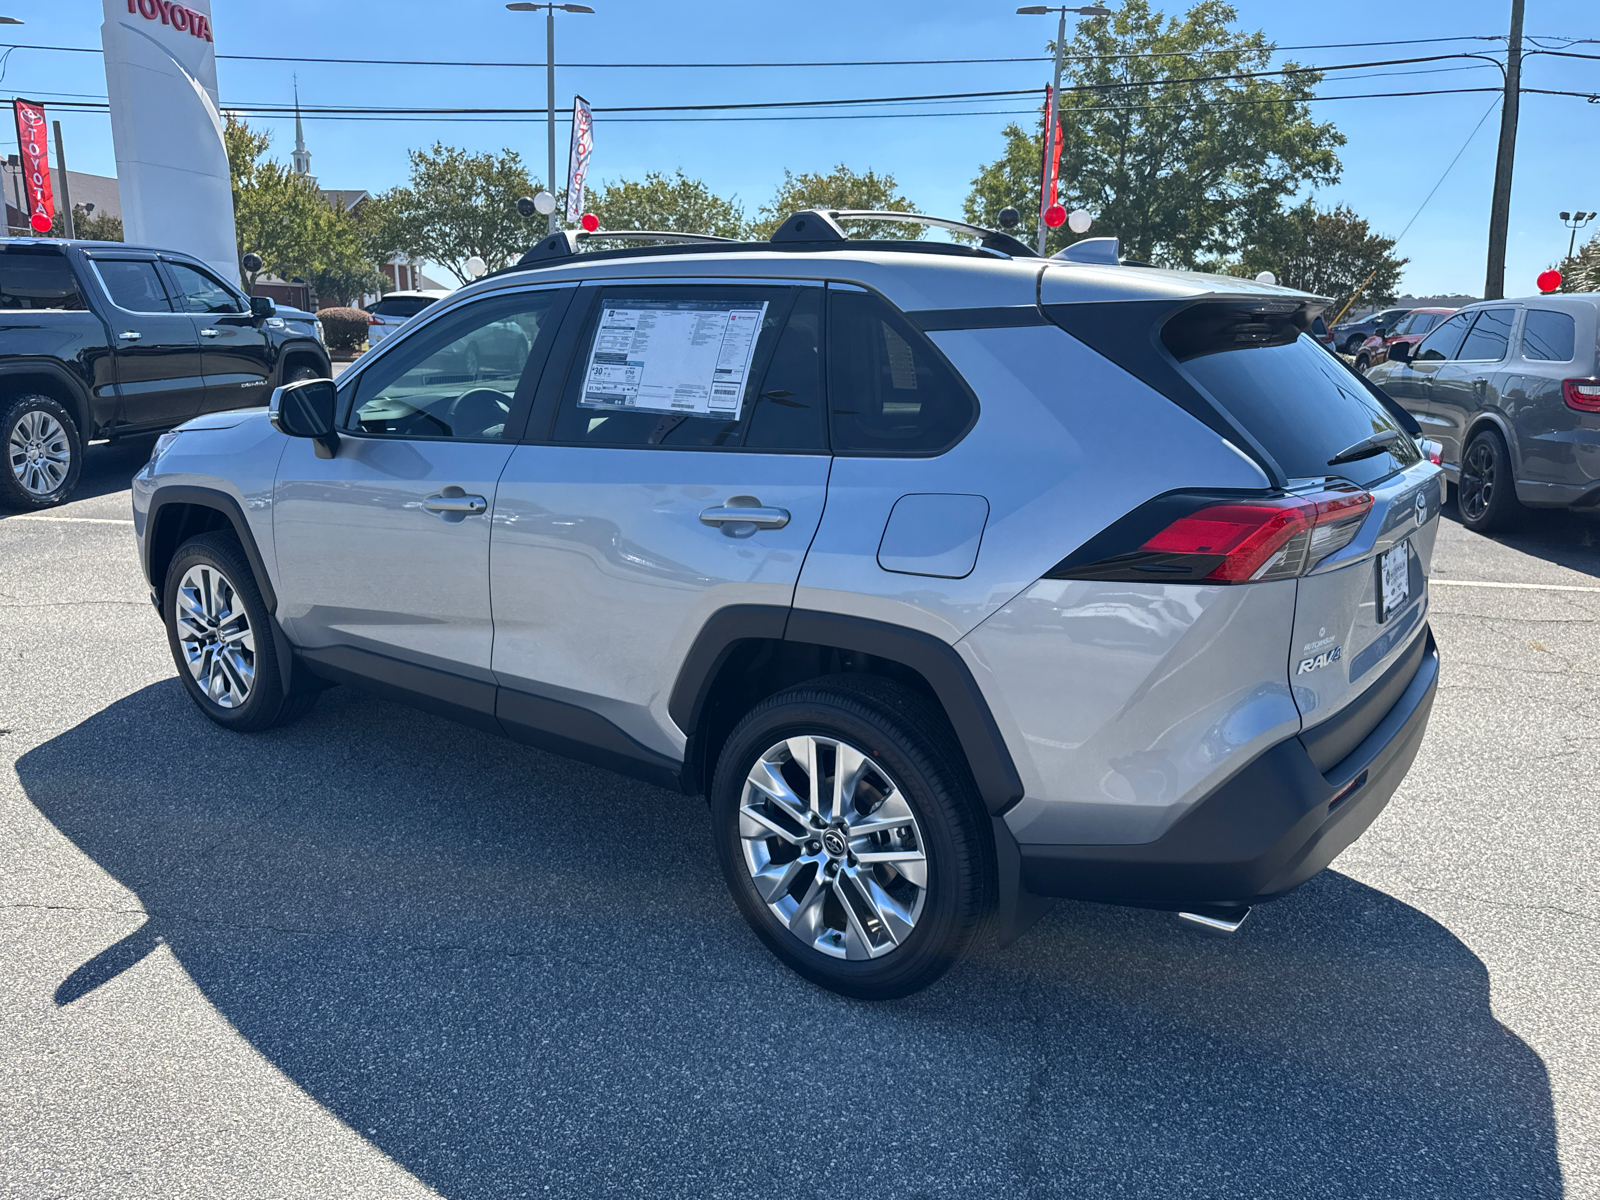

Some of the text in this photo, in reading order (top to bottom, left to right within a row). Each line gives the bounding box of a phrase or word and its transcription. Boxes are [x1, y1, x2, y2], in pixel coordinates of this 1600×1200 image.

[27, 128, 47, 215] TOYOTA
[1303, 635, 1336, 652] HUTCHINSON
[1296, 645, 1342, 676] RAV4
